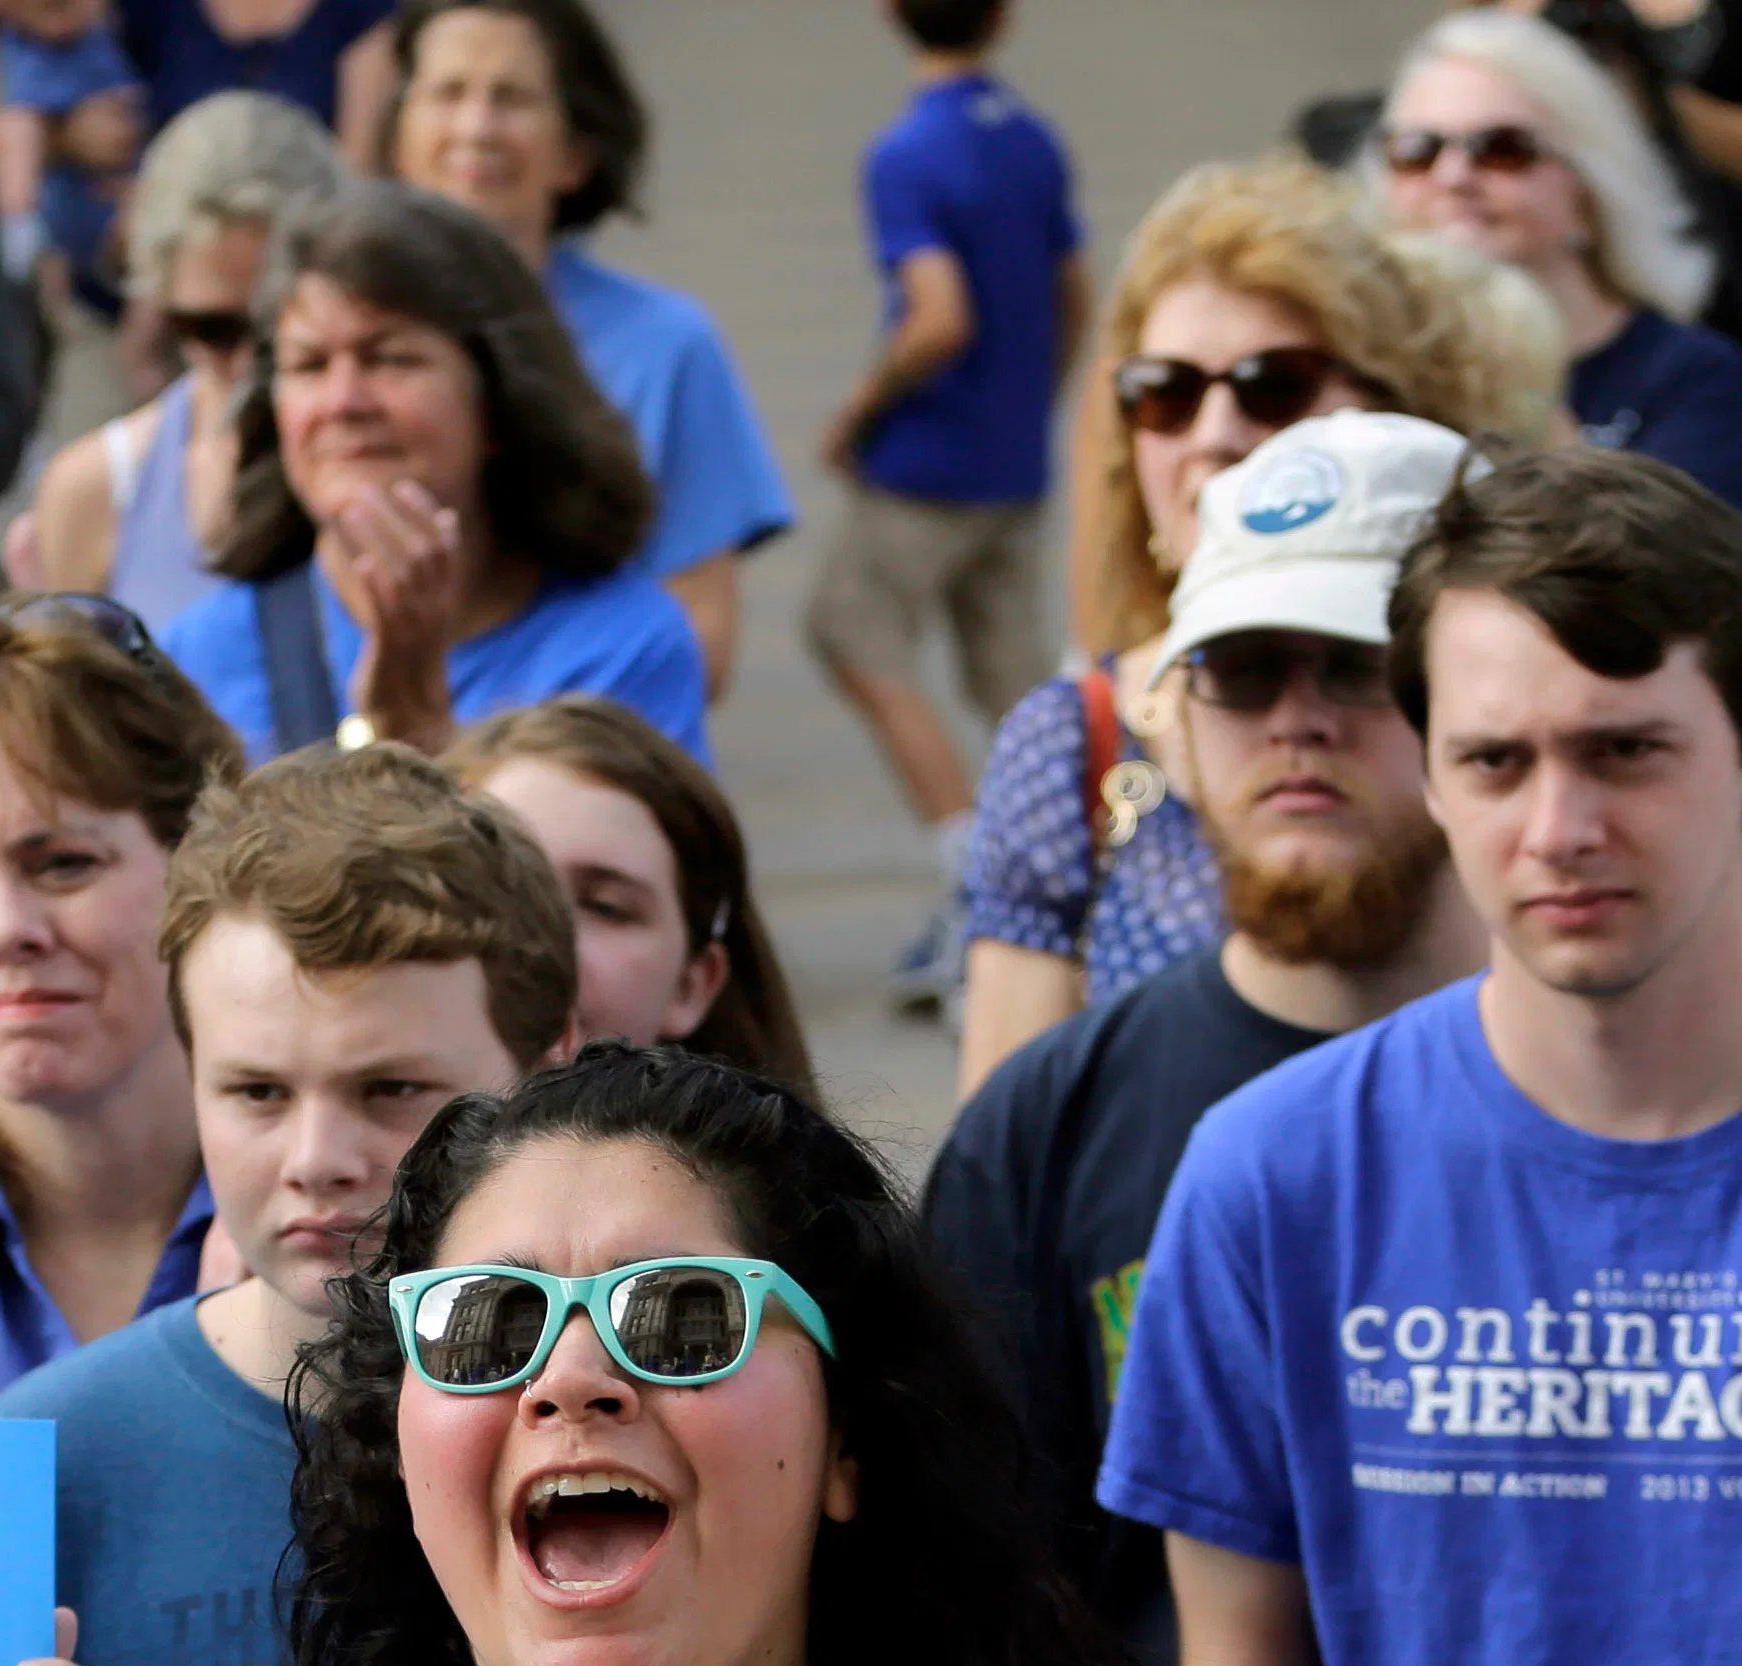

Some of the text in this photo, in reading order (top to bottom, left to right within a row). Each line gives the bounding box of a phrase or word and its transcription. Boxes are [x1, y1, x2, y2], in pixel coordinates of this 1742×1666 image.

[1345, 1368, 1408, 1410] the
[1460, 1470, 1496, 1496] IN
[1498, 1471, 1608, 1499] ACTION
[1640, 1472, 1710, 1501] 2013
